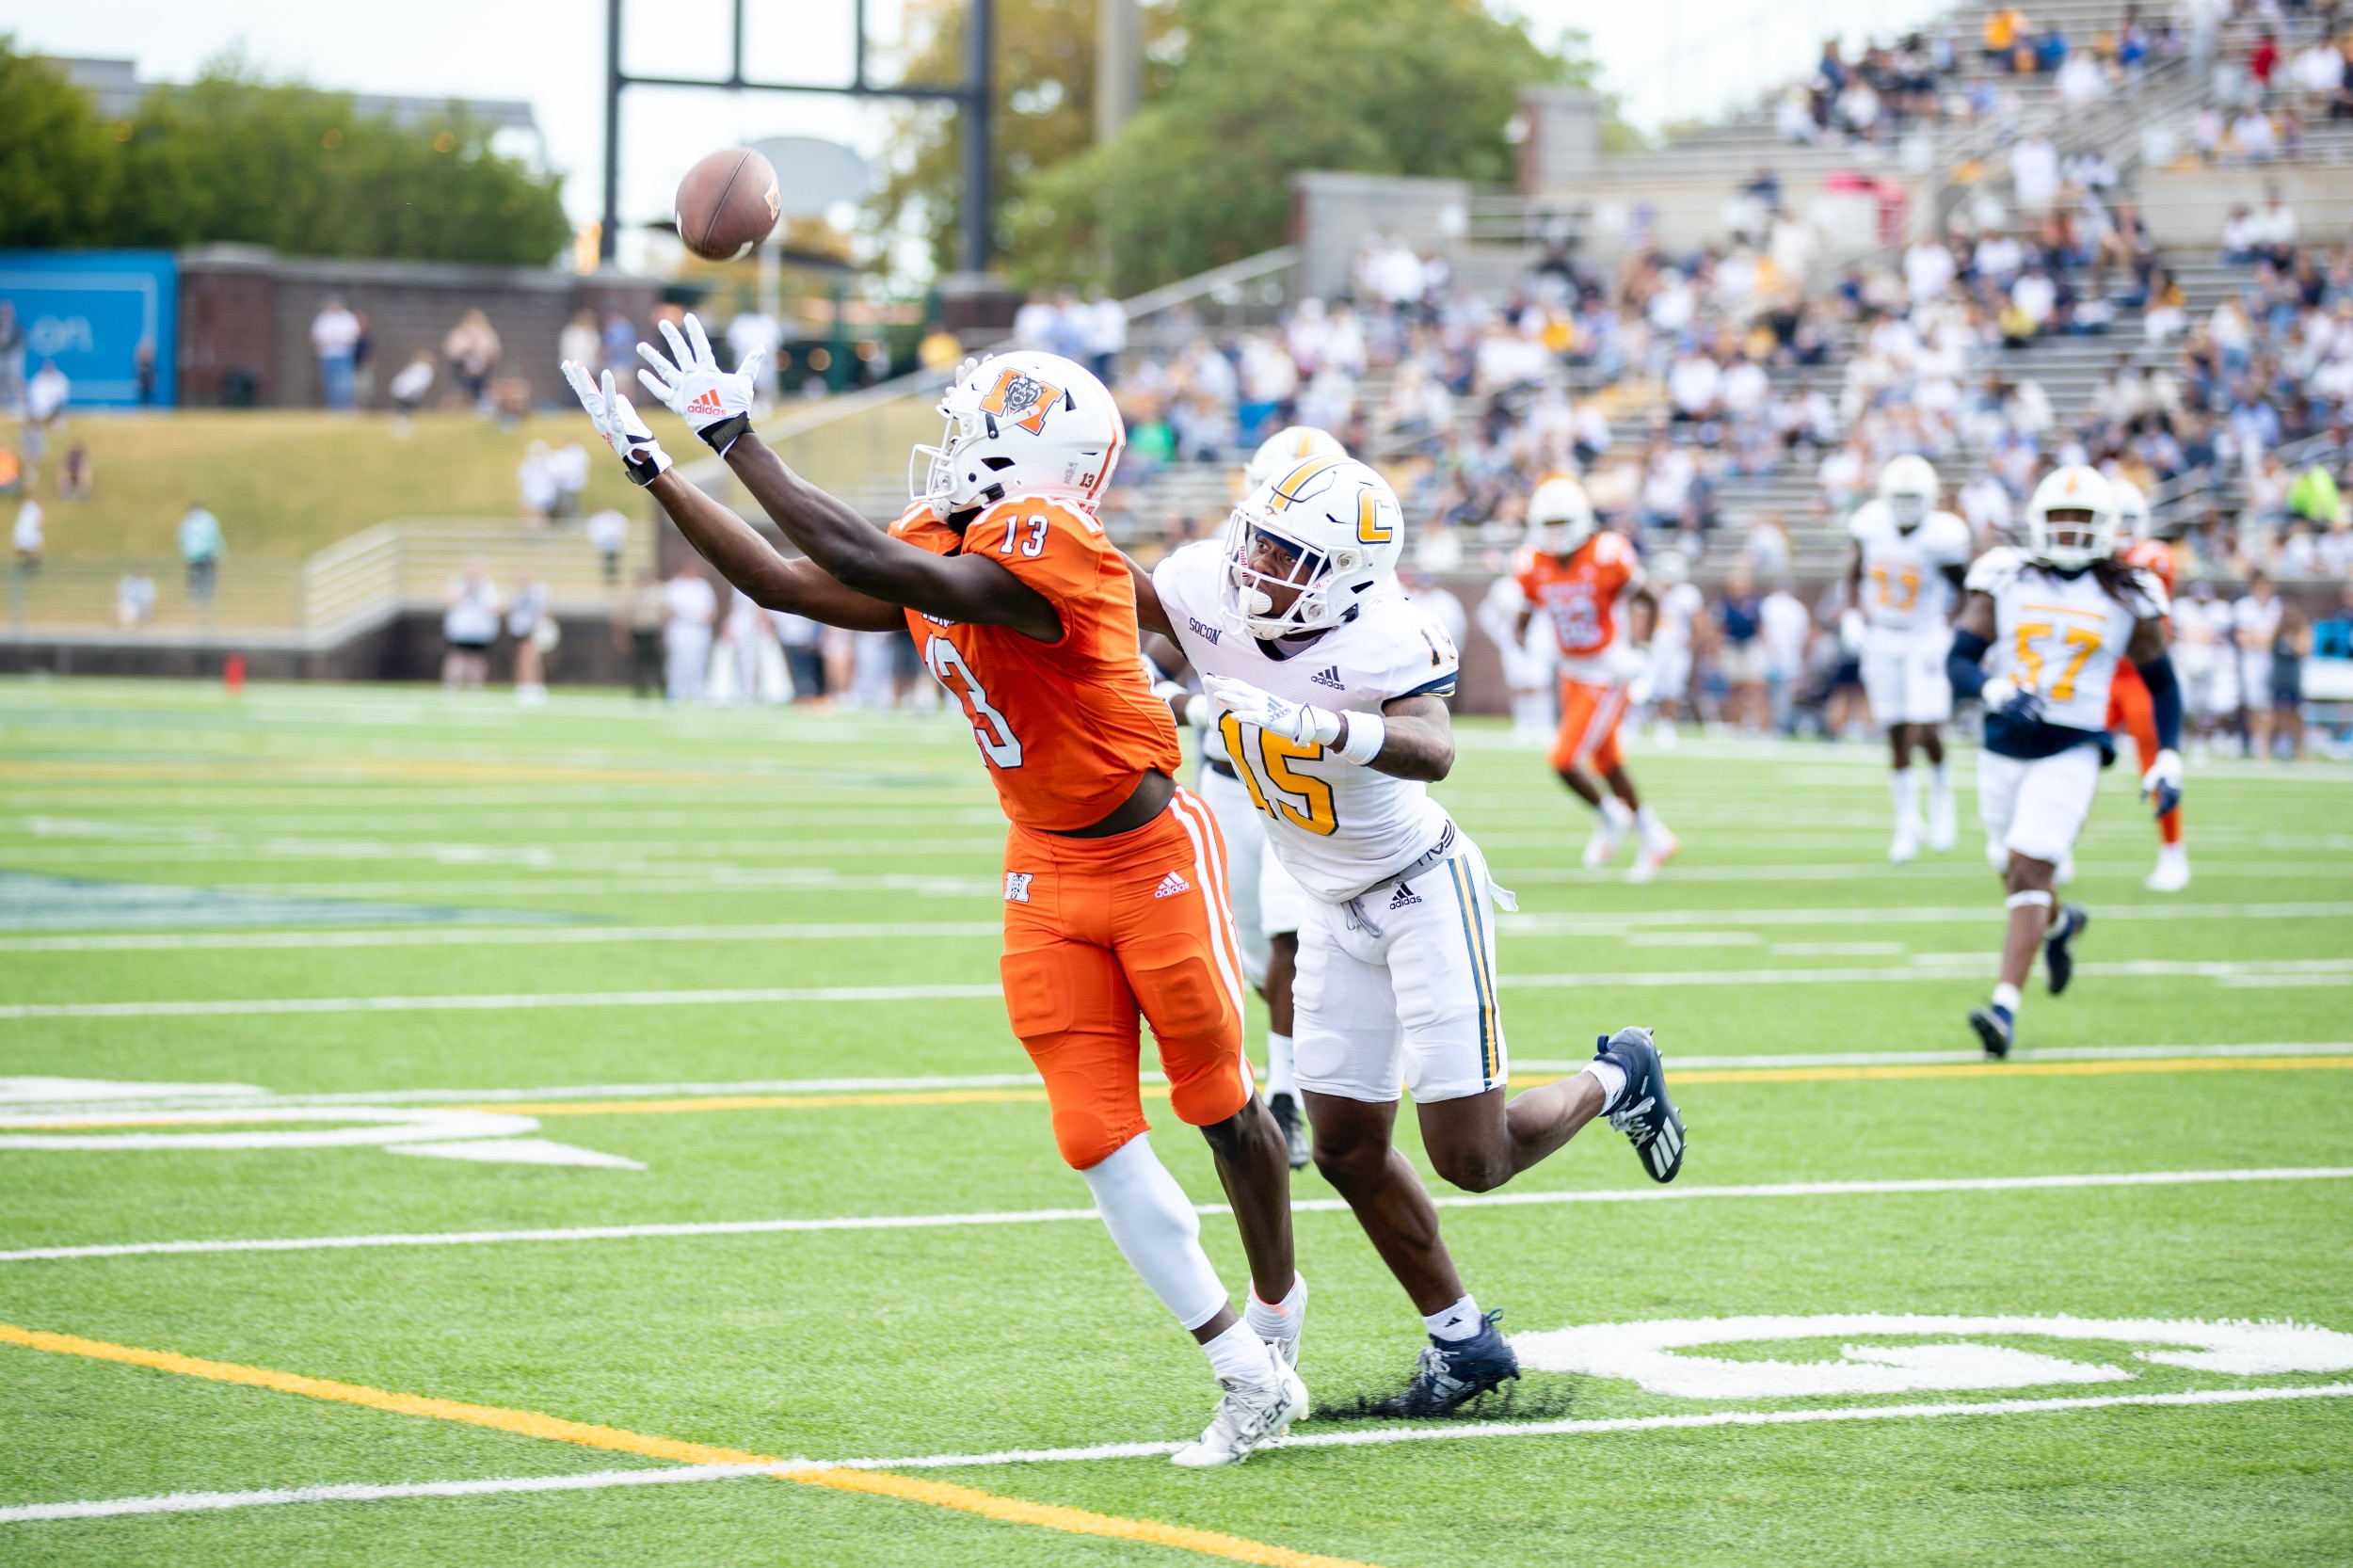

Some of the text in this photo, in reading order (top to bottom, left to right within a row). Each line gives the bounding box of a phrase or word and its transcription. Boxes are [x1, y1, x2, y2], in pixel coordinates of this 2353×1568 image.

[687, 404, 728, 416] adidas
[1079, 472, 1096, 488] 13
[1356, 488, 1393, 544] C
[1000, 514, 1049, 557] 13
[1239, 546, 1249, 578] Riddll
[2009, 622, 2103, 702] 57
[1310, 675, 1346, 691] adidas
[1219, 710, 1339, 836] 15
[1154, 881, 1191, 899] adidas
[1389, 894, 1423, 911] adidas
